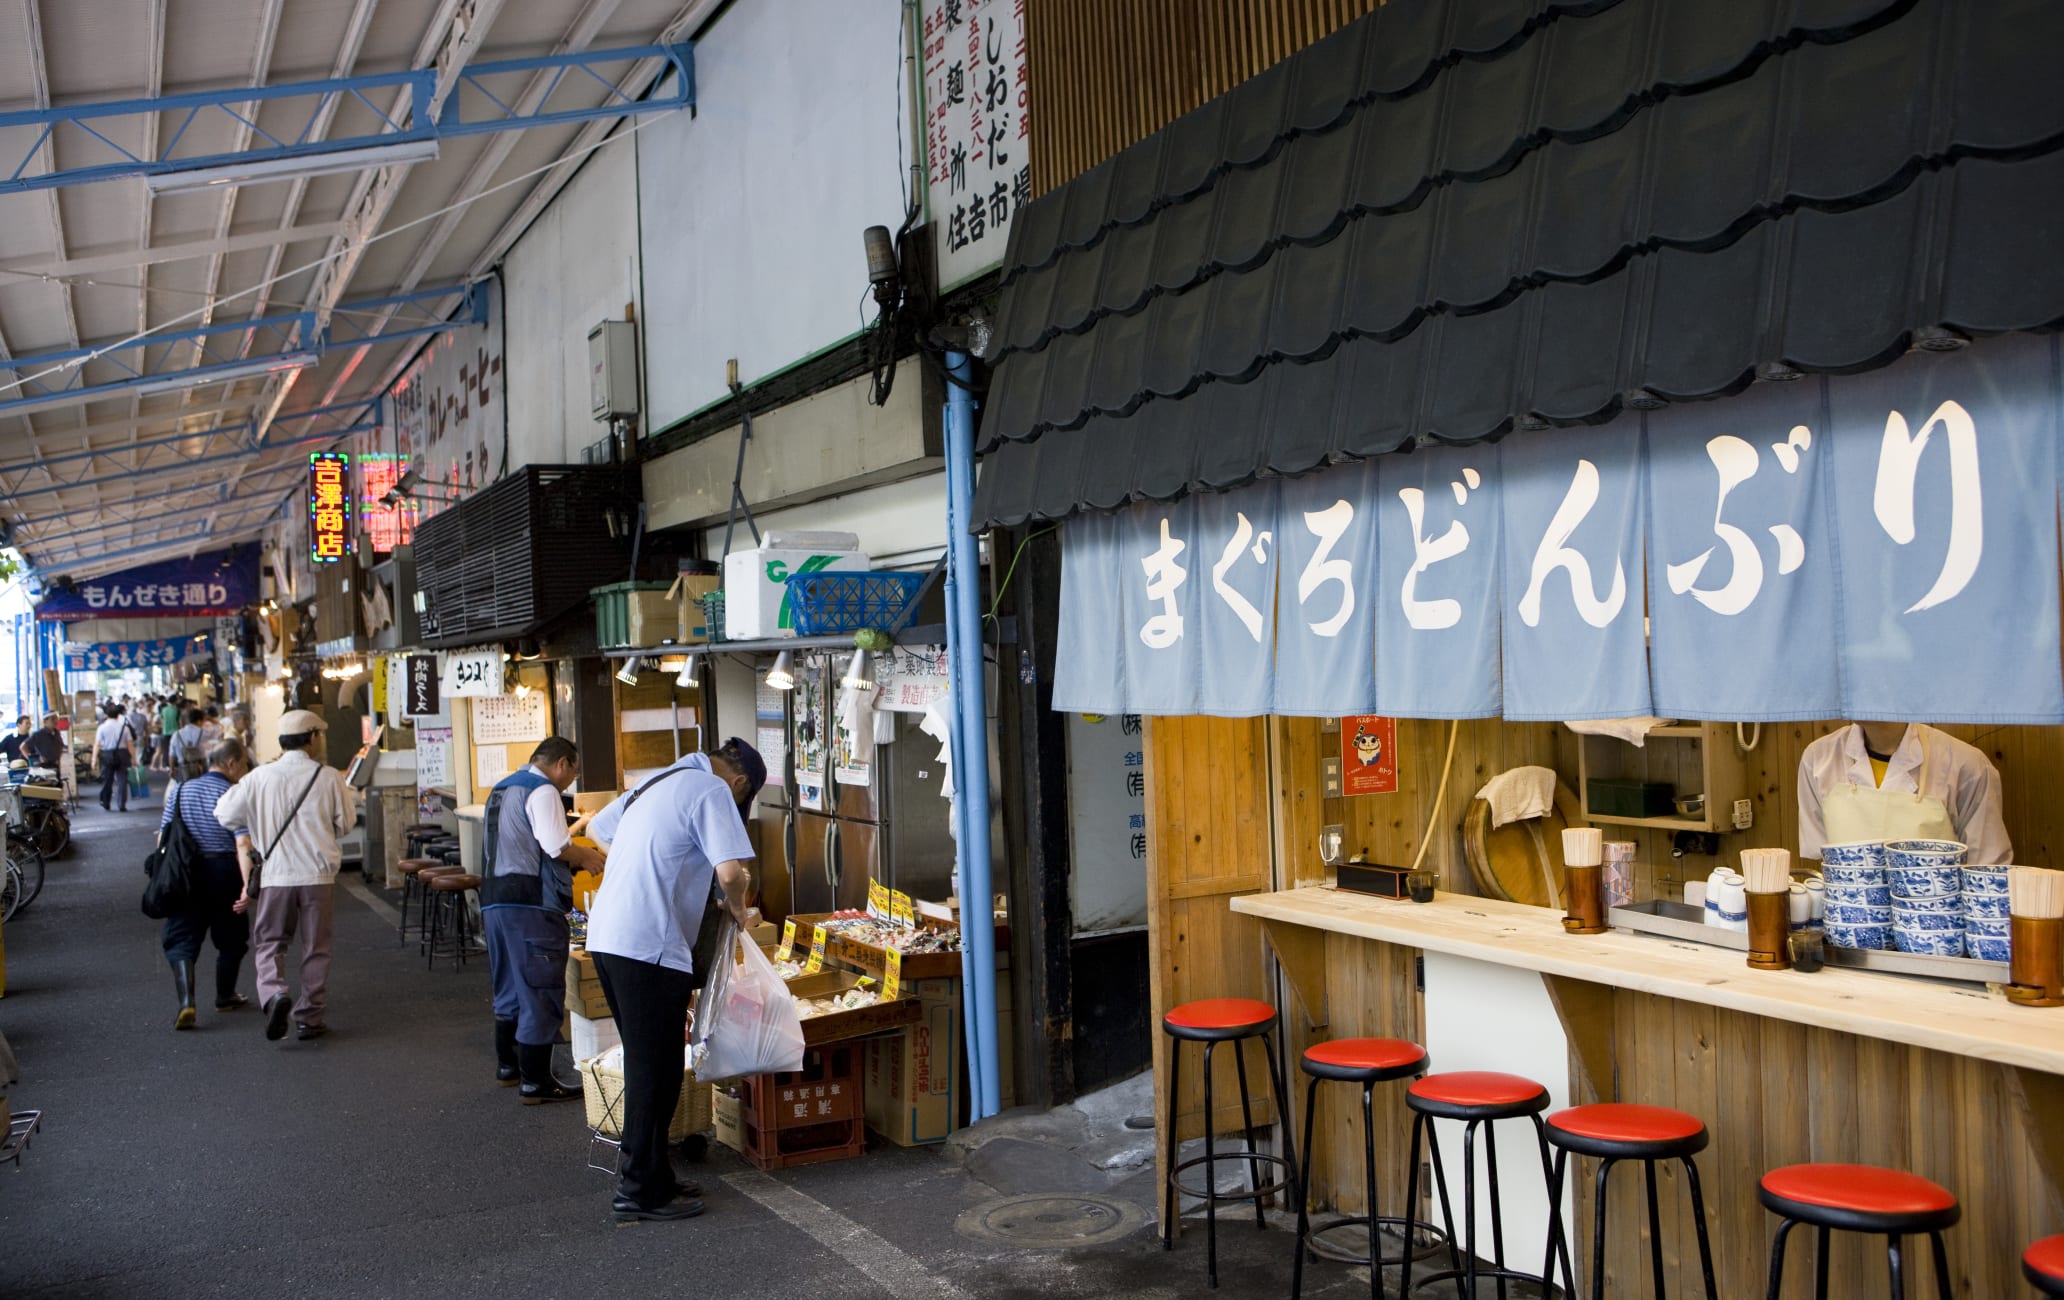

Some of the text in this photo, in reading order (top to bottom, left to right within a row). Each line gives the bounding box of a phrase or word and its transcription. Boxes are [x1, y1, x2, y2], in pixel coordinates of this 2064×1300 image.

[985, 16, 1009, 170] しおだ
[315, 459, 343, 556] 吉澤商店
[1139, 400, 1984, 649] まぐろどんぶり
[83, 584, 227, 608] もんぜき通り
[793, 1099, 832, 1118] 清酒
